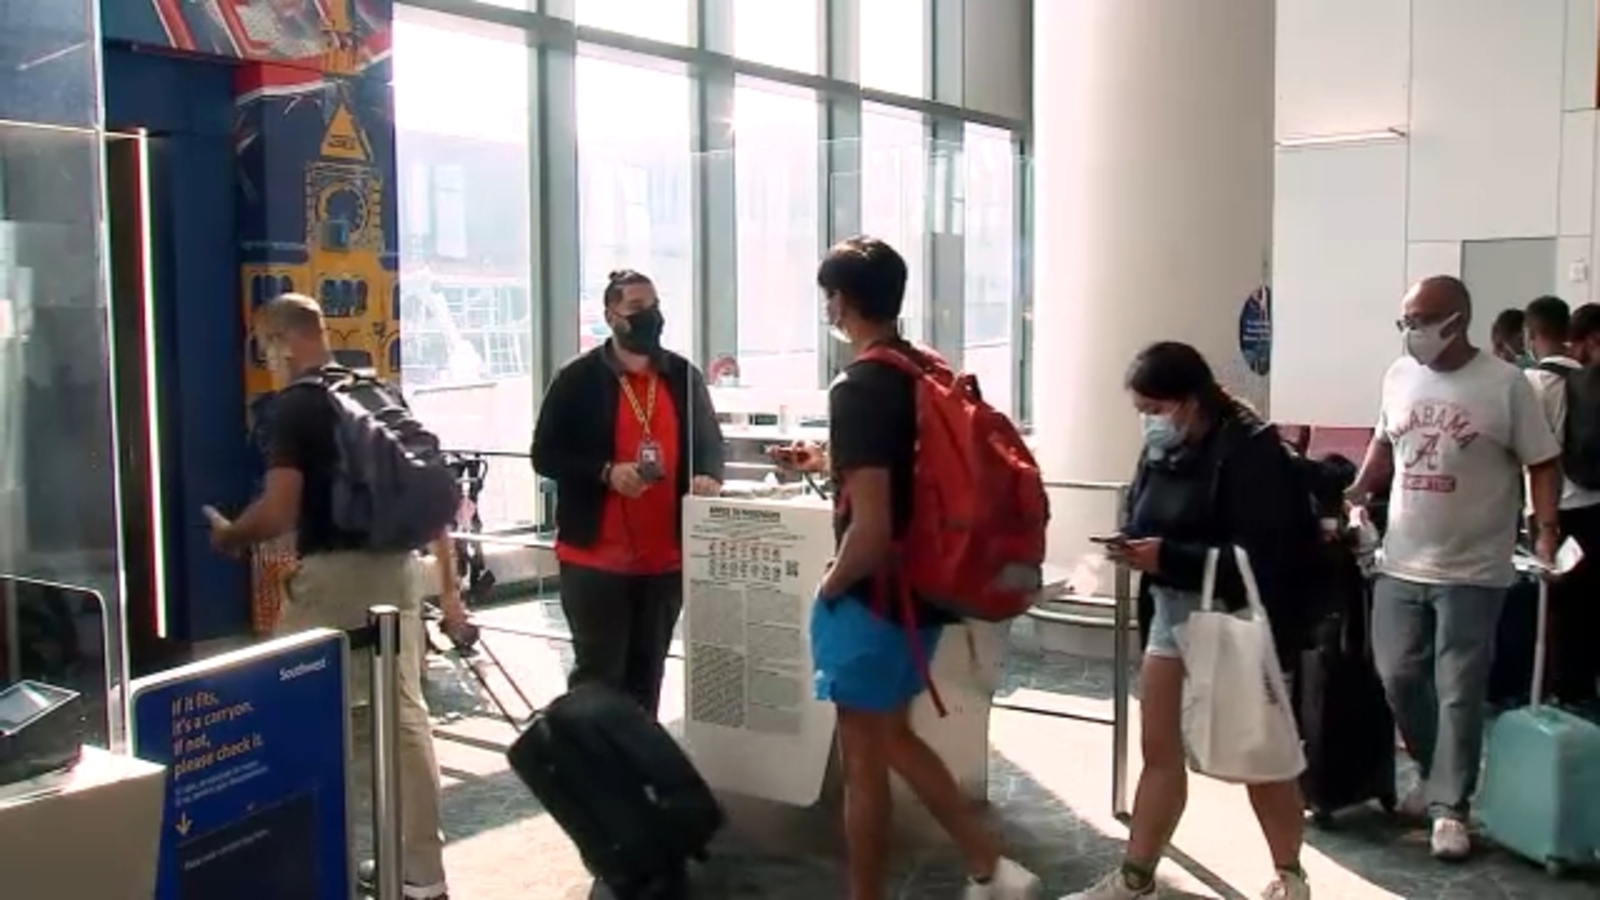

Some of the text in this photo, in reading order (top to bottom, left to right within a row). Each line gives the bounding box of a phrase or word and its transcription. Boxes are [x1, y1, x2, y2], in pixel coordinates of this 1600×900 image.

[278, 657, 327, 681] Southwest
[174, 753, 215, 780] please
[216, 738, 250, 761] check
